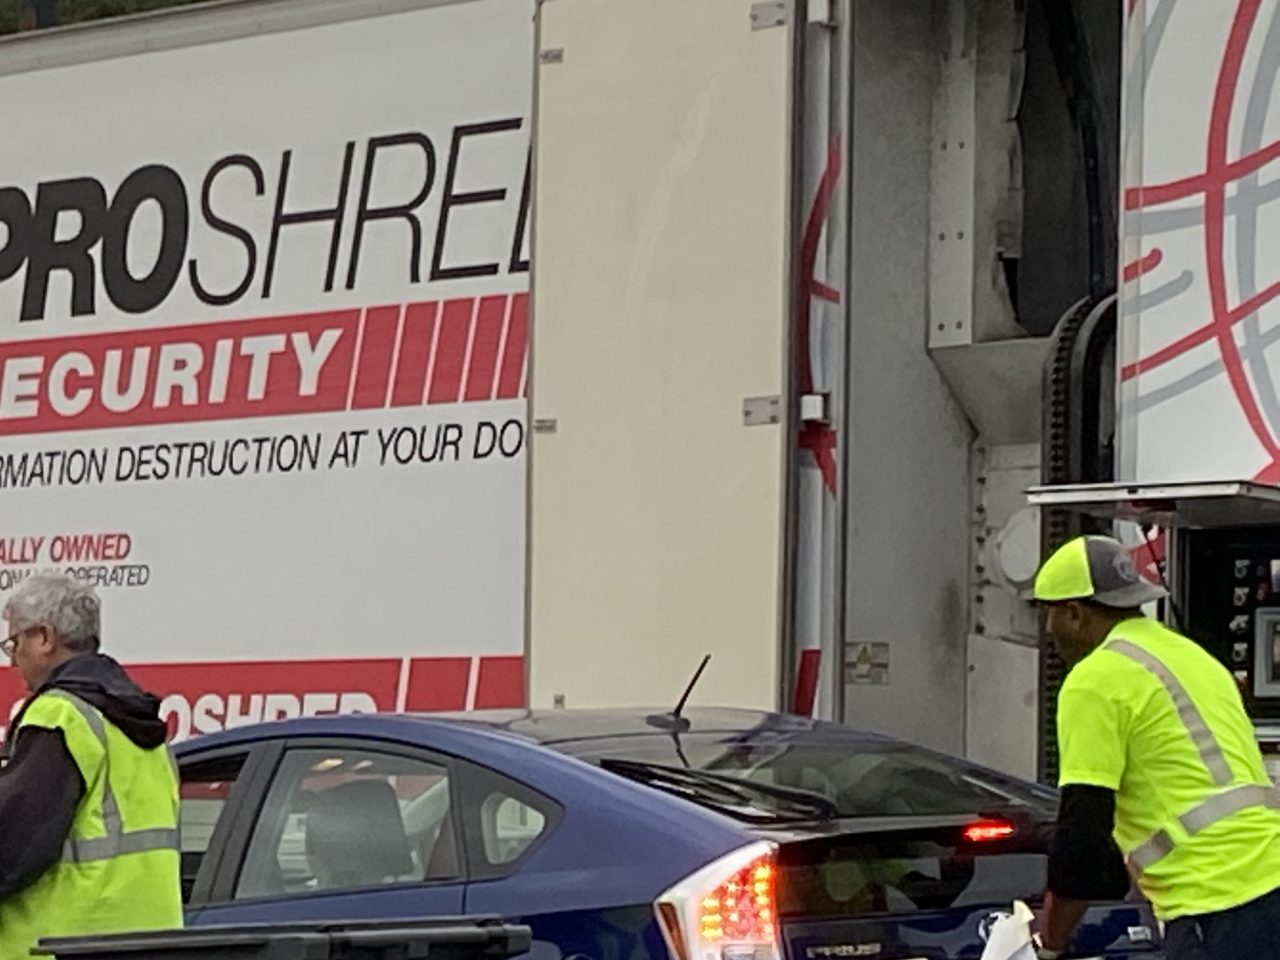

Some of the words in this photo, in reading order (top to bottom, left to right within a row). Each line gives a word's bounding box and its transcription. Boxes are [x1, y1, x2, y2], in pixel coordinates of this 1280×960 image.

[115, 433, 322, 482] DESTRUCTION
[328, 430, 369, 469] AT
[377, 423, 463, 466] YOUR
[473, 419, 528, 460] DO
[50, 533, 132, 562] OWNED
